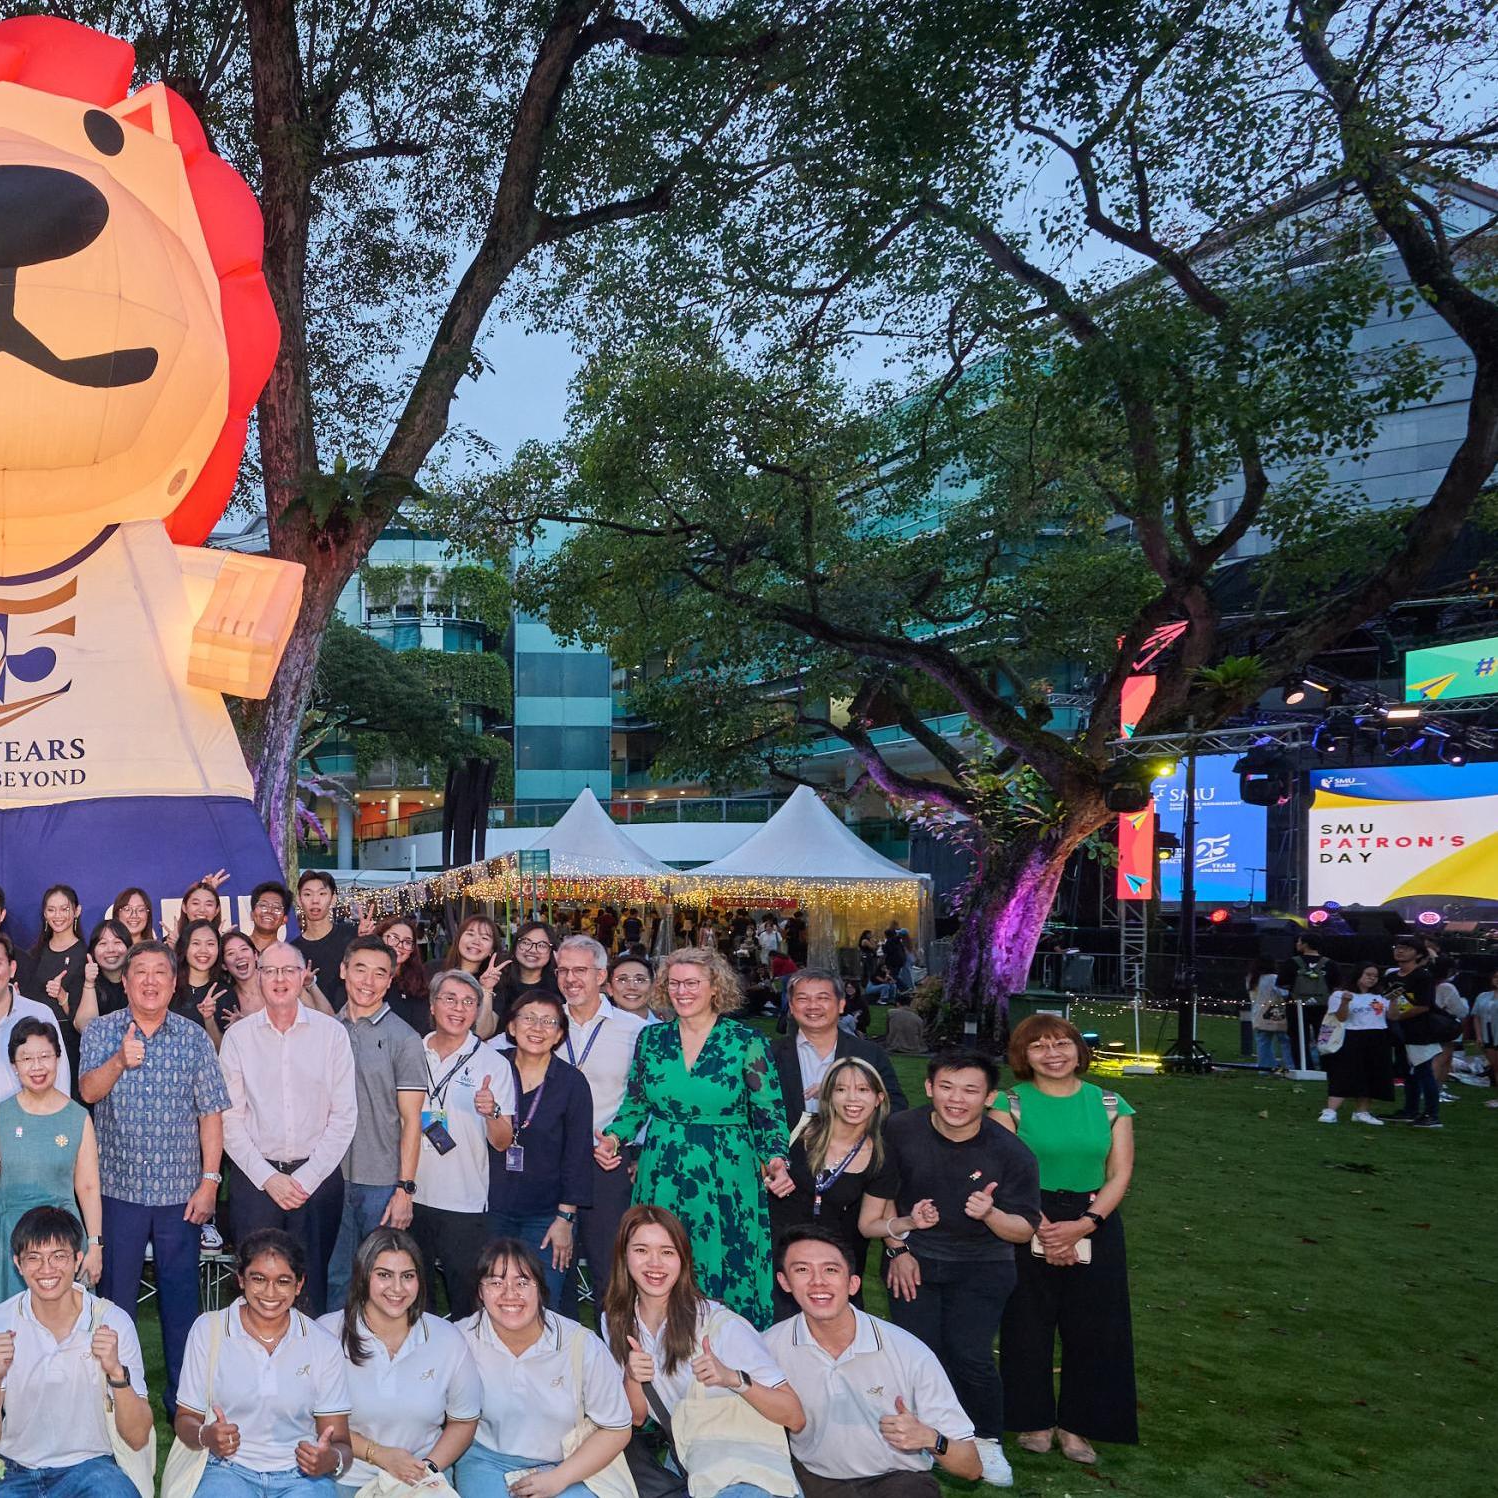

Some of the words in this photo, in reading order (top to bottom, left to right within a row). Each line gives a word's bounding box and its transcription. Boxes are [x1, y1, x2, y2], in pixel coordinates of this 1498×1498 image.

[1320, 823, 1374, 835] SMU
[1319, 835, 1465, 849] PATRON'S
[1319, 852, 1373, 864] DAY
